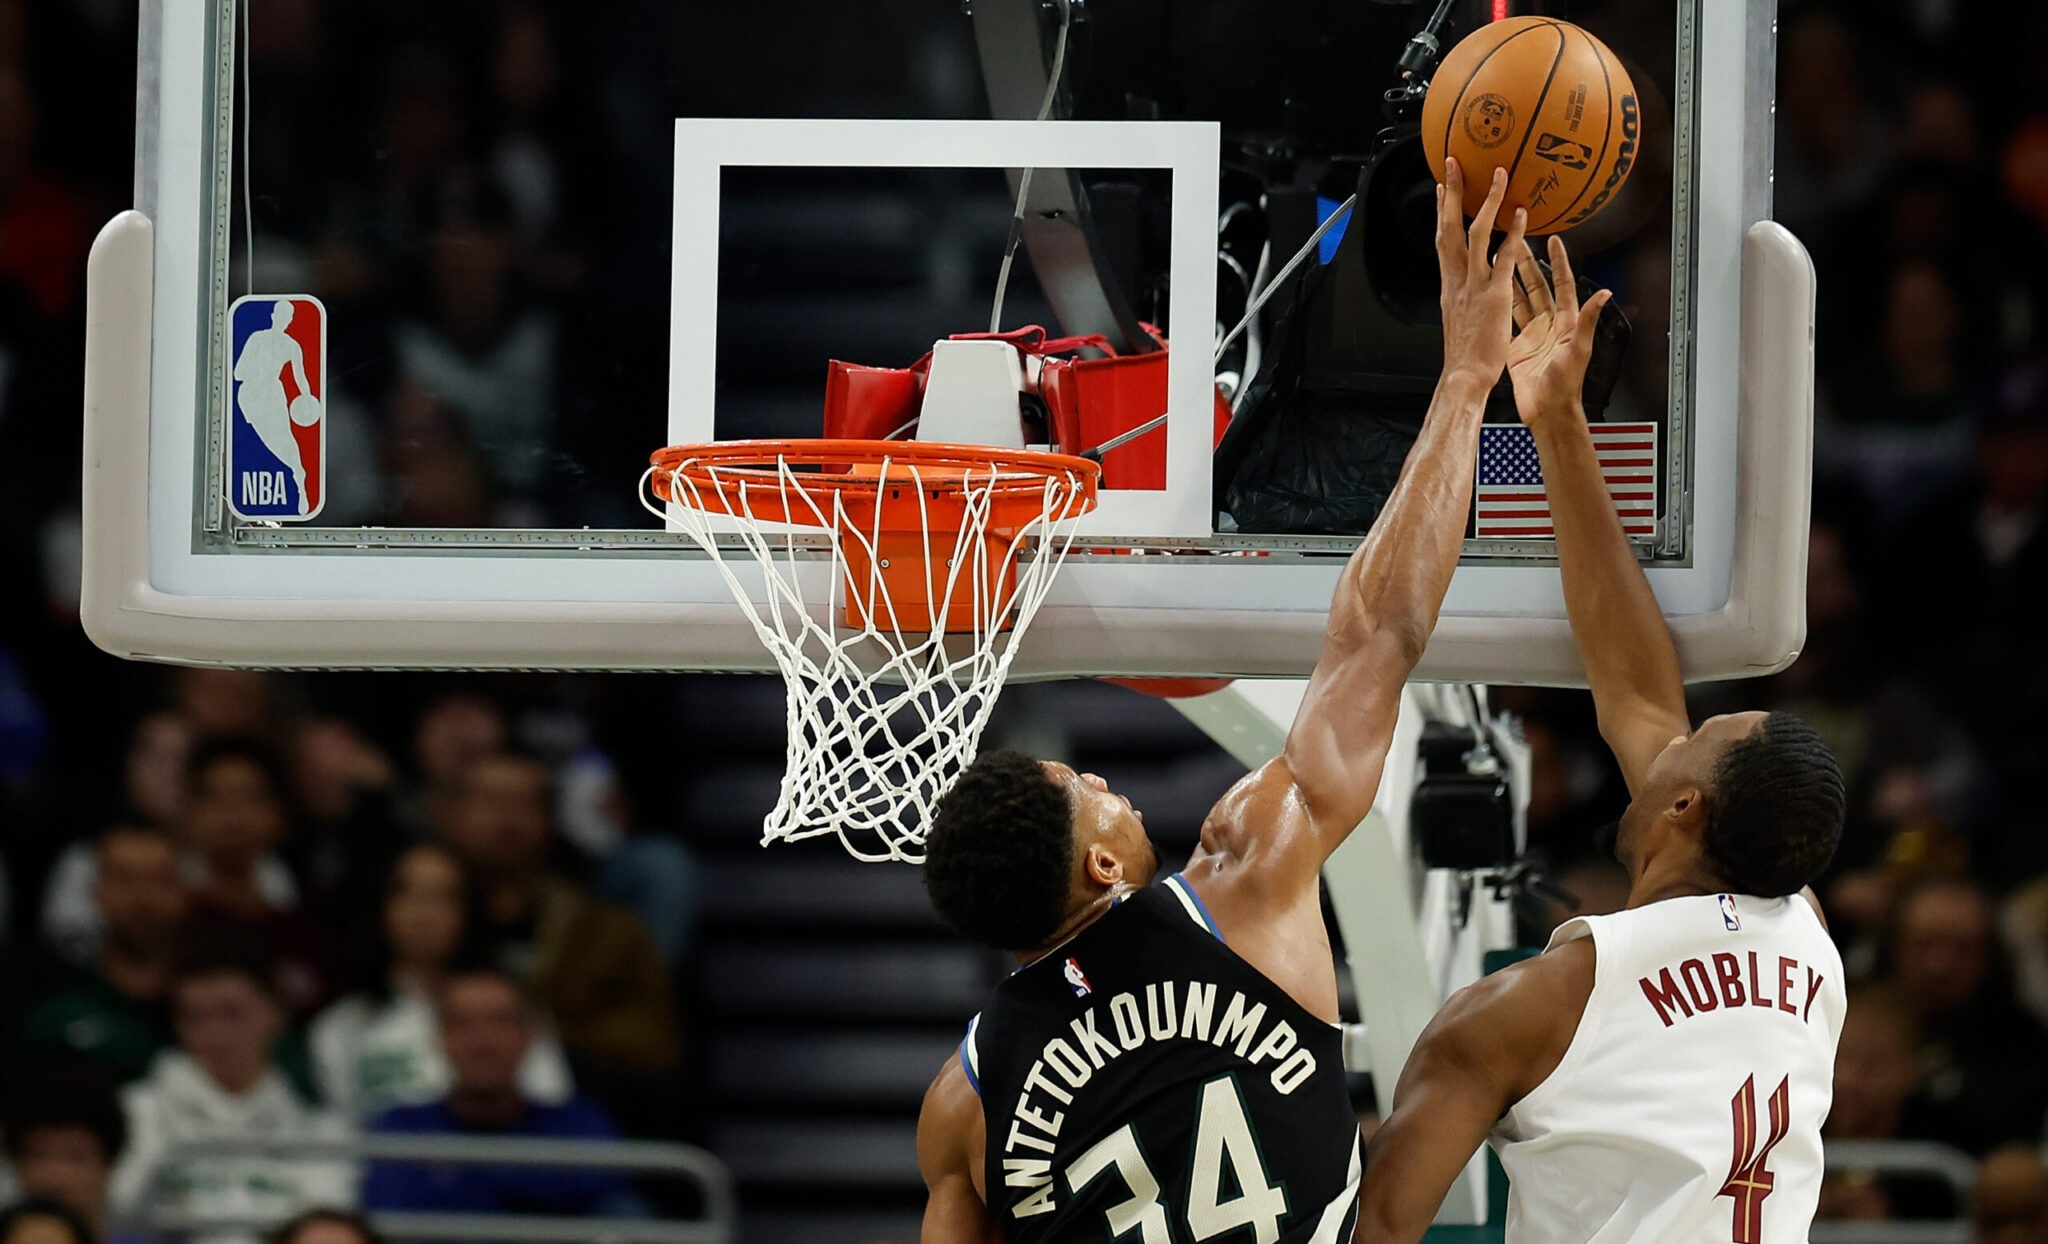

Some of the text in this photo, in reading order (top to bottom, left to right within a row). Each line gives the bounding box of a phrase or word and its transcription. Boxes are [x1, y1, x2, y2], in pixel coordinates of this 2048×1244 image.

[242, 471, 287, 506] NBA
[1638, 951, 1824, 1028] MOBLEY
[1003, 981, 1317, 1219] ANTETOKOUNMPO
[1065, 1074, 1288, 1244] 34
[1712, 1072, 1790, 1244] 4
